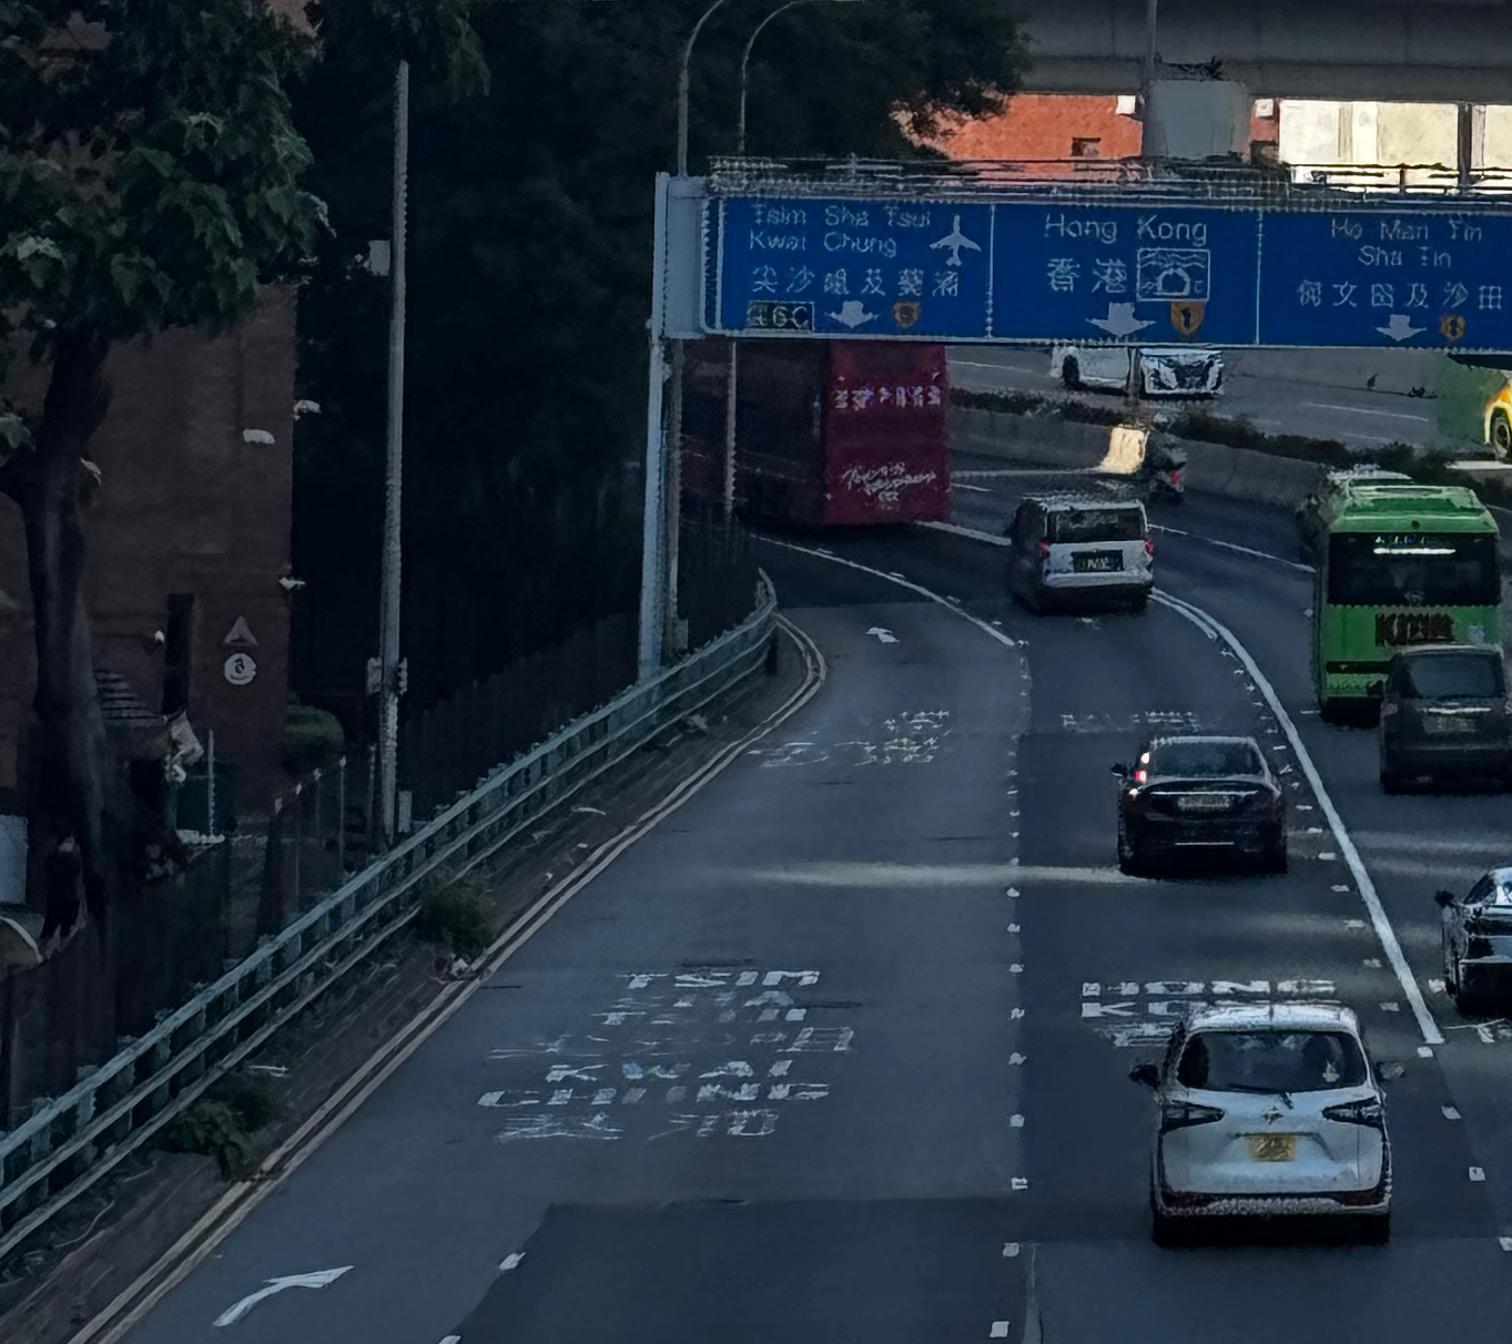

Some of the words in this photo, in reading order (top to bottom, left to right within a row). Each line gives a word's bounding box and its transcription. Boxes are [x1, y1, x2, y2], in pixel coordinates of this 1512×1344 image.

[750, 203, 808, 226] Tsim
[823, 205, 870, 227] Sha
[884, 205, 932, 228] Tsui
[1044, 213, 1118, 245] Hong
[1137, 214, 1208, 248] Kong
[1331, 217, 1364, 239] Ho
[1380, 219, 1430, 240] Man
[749, 229, 808, 251] Kwai
[823, 231, 897, 258] Chung
[1047, 258, 1128, 294] 香港
[616, 970, 821, 990] TSIM
[1082, 979, 1337, 997] HONG
[545, 1060, 794, 1083] KWAI
